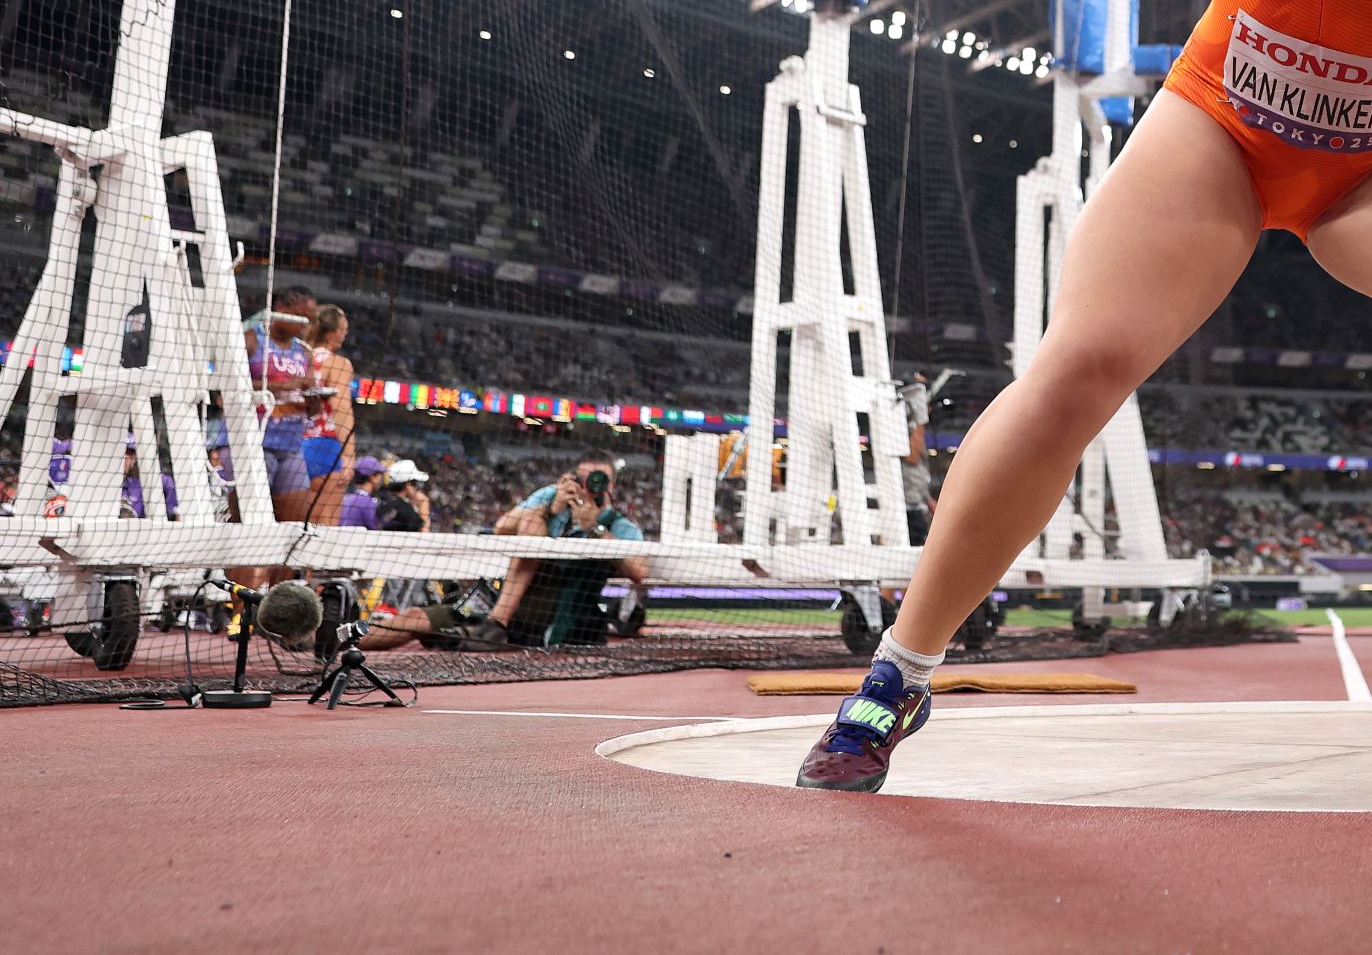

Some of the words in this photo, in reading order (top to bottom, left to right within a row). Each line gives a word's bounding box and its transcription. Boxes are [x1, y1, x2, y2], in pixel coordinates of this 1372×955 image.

[1232, 56, 1277, 106] VAN
[272, 353, 306, 378] USA
[845, 699, 896, 733] NIKE
